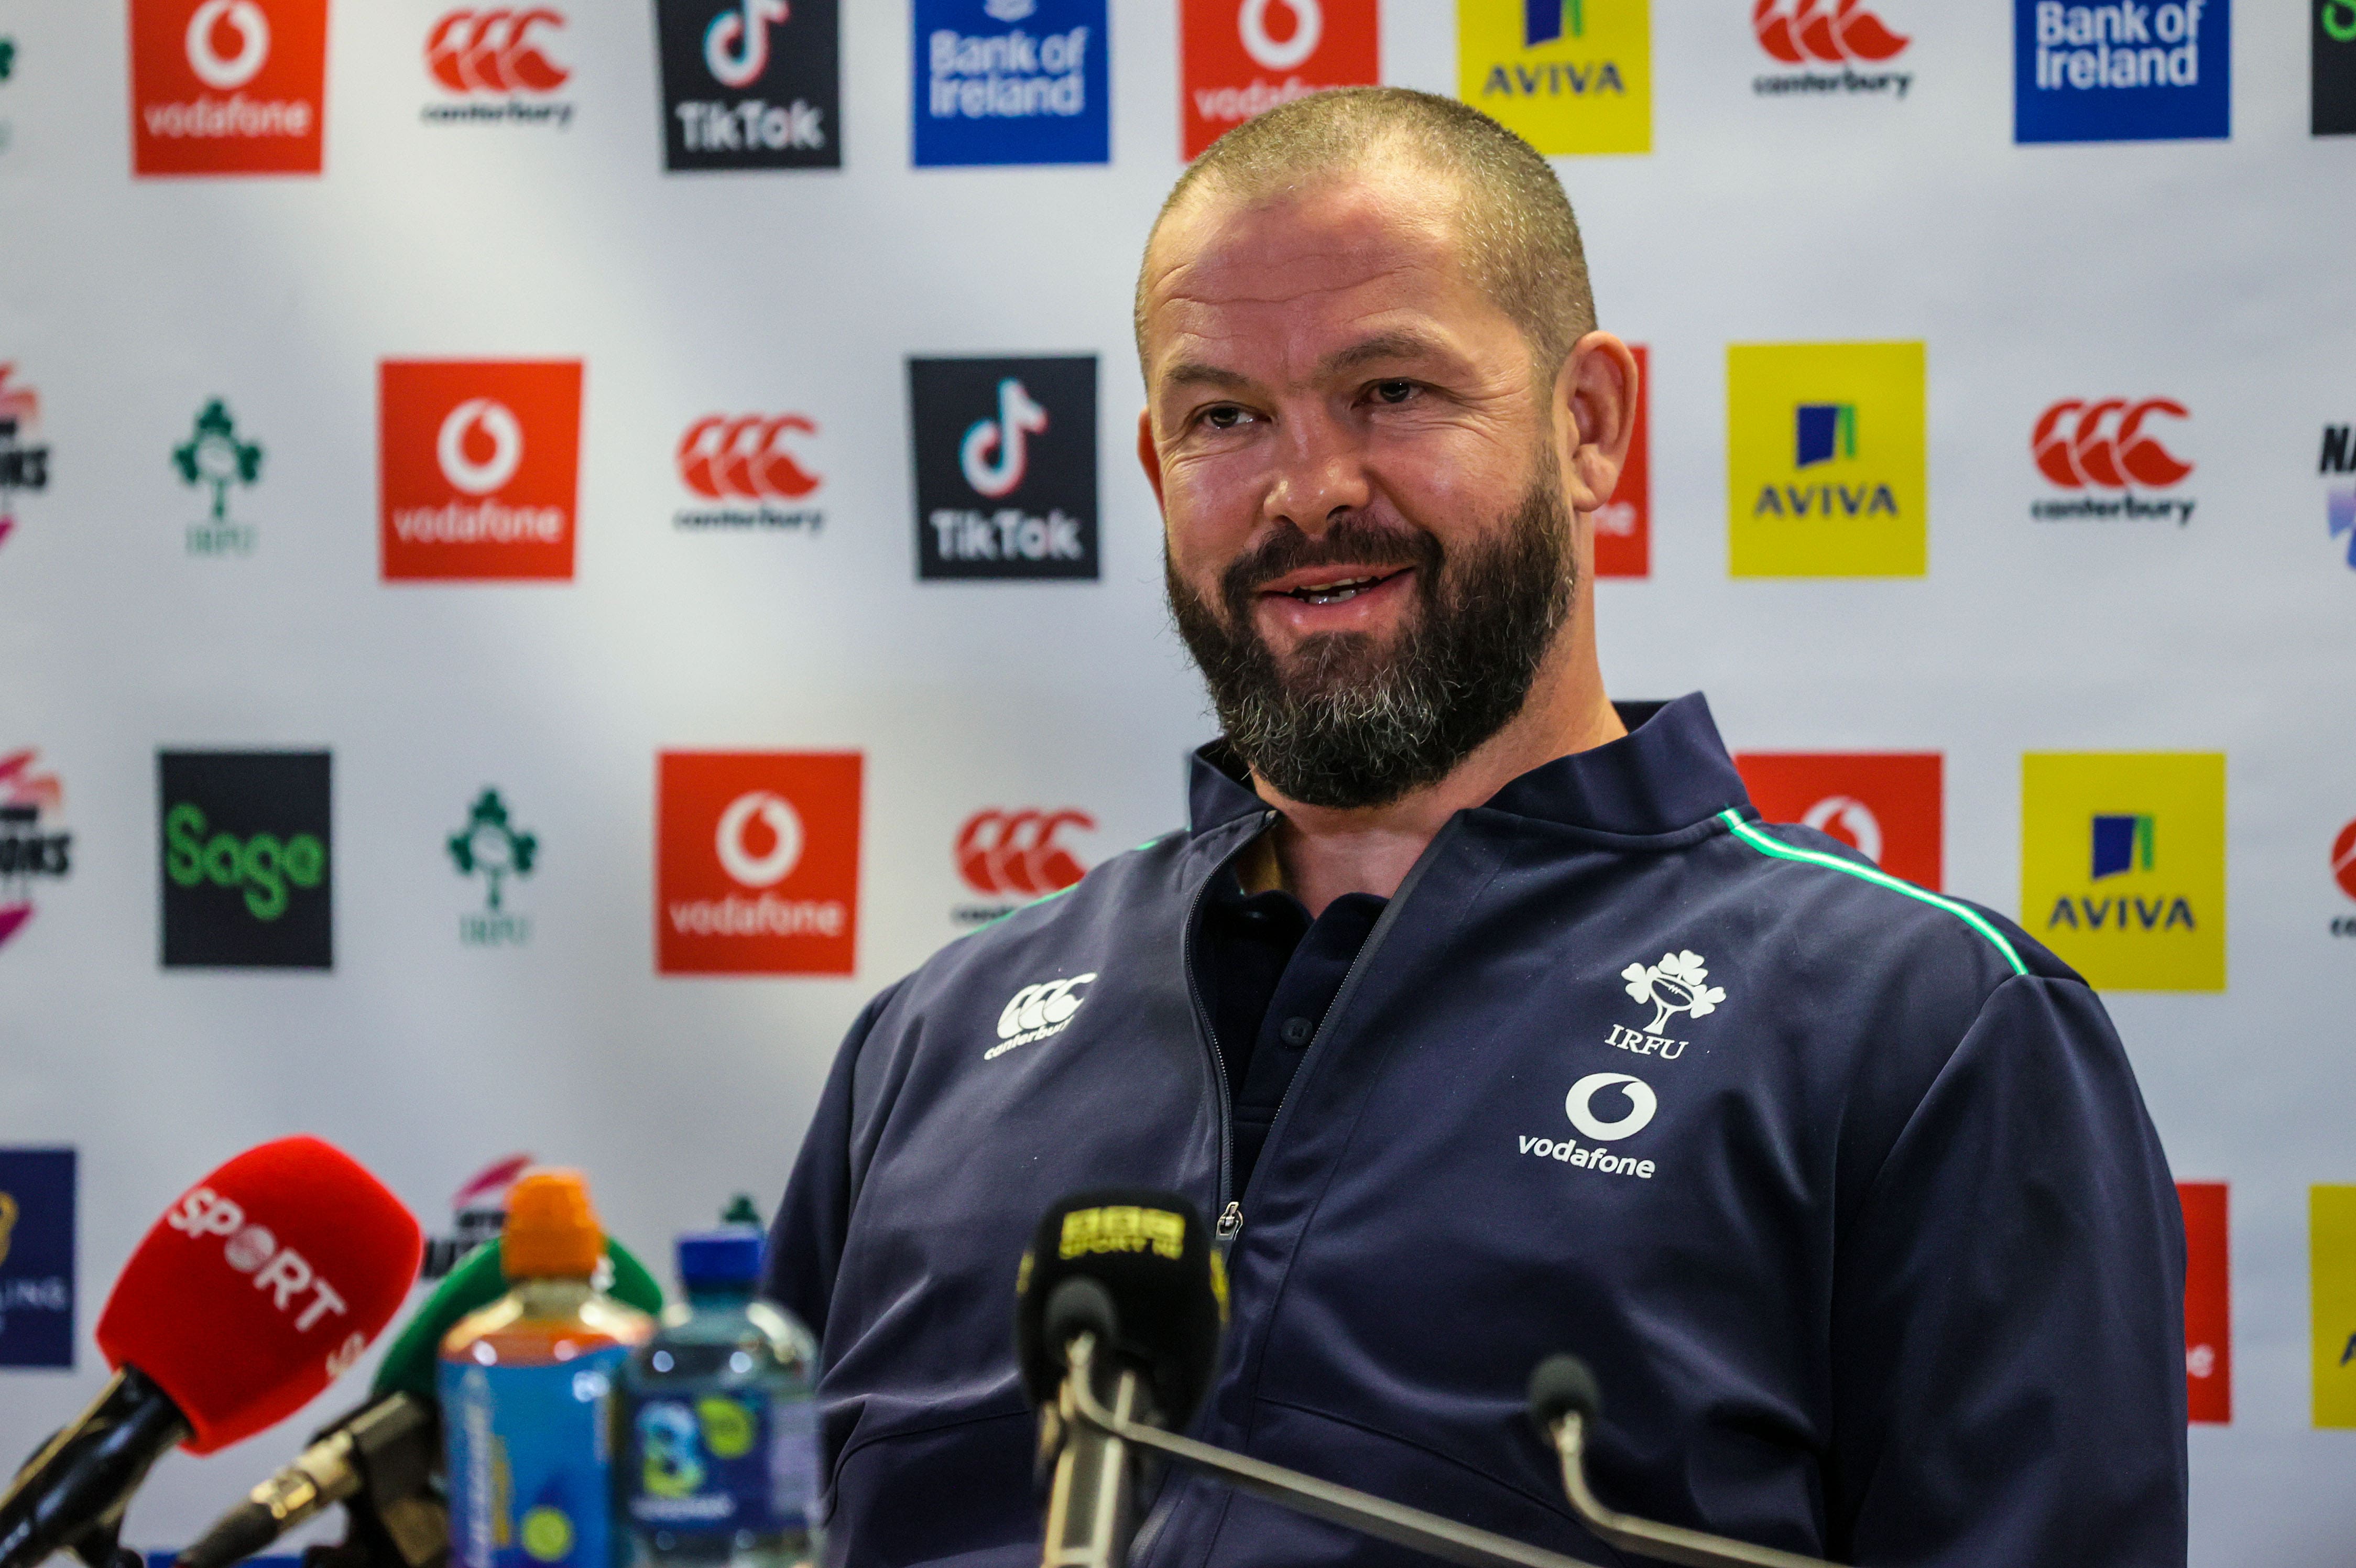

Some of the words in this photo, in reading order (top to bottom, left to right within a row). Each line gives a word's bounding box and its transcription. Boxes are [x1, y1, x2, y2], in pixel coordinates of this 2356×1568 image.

[2036, 0, 2151, 45] Bank
[2155, 0, 2206, 44] of
[929, 29, 1037, 73] Bank
[1040, 26, 1089, 73] of
[2036, 43, 2198, 90] Ireland
[929, 75, 1084, 118] Ireland
[1482, 63, 1626, 97] AVIVA
[1753, 67, 1912, 100] canterbury
[144, 94, 308, 137] vodafone
[675, 100, 824, 150] TikTok
[392, 498, 564, 543] vodafone
[1754, 484, 1899, 517] AVIVA
[2031, 491, 2196, 527] canterbury
[929, 509, 1083, 560] TikTok
[669, 894, 845, 937] vodafone
[2047, 895, 2195, 932] AVIVA
[1605, 1024, 1689, 1060] IRFU
[1519, 1135, 1655, 1179] vodafone
[167, 1186, 348, 1333] SPORT
